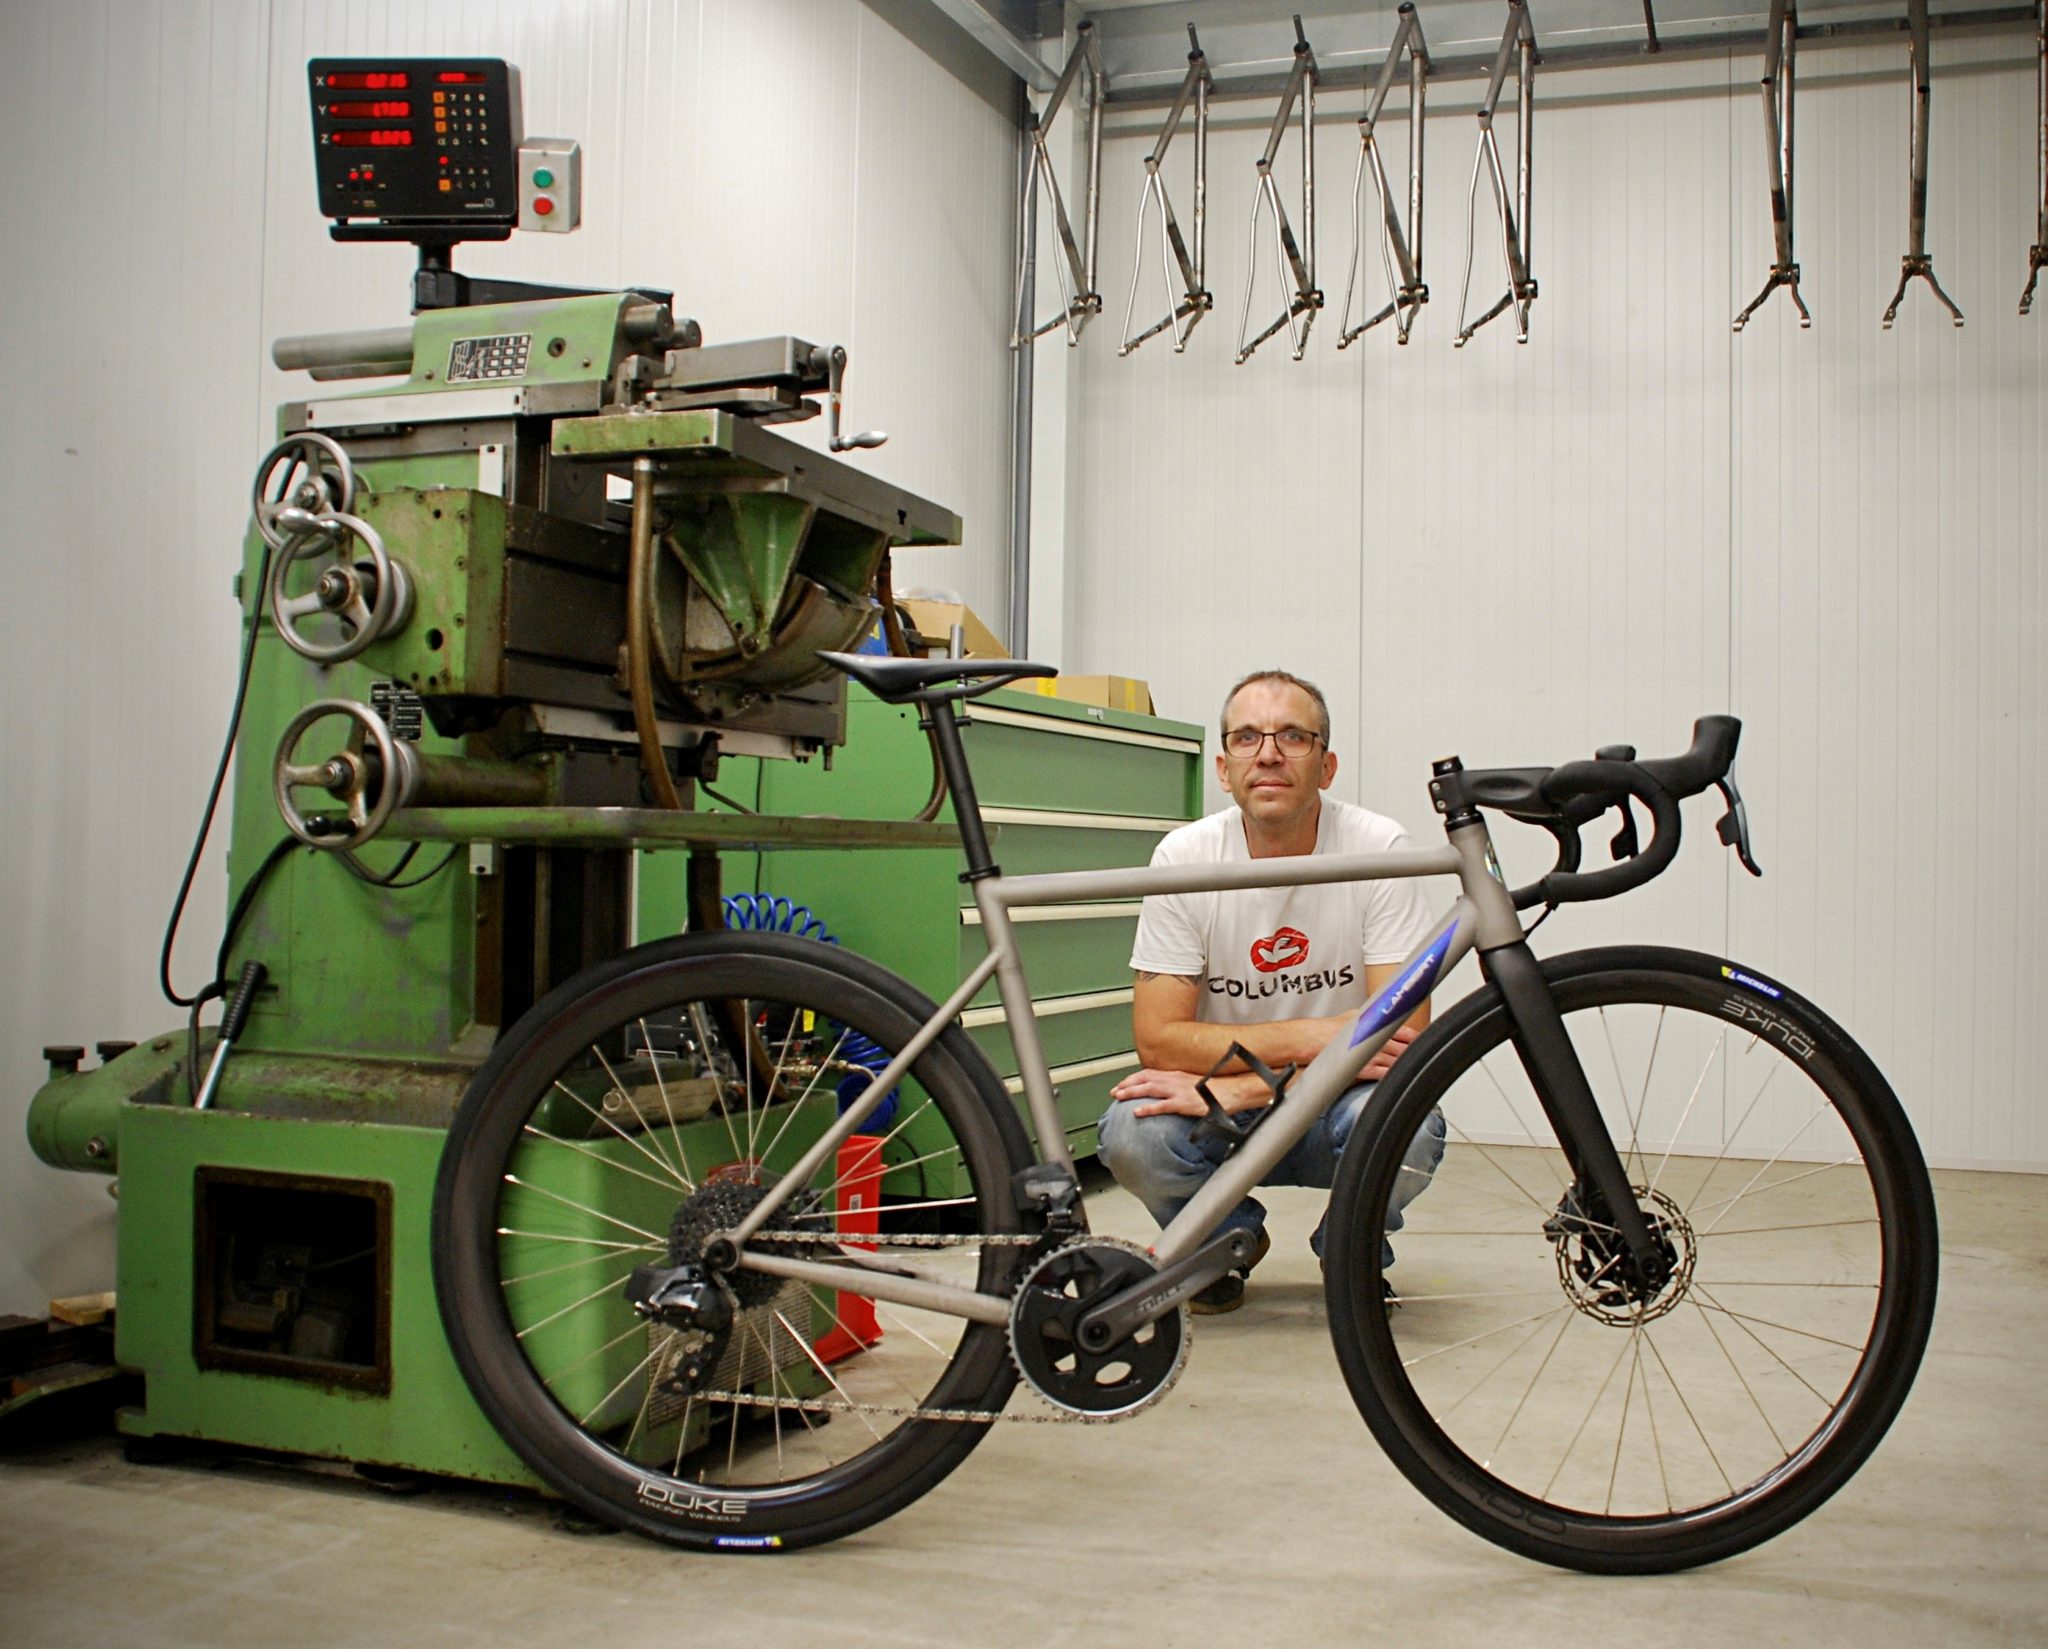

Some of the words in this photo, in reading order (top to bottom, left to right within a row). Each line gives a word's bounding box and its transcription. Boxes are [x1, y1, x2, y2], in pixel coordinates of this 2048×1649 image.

[316, 76, 325, 86] X
[318, 105, 327, 115] Y
[320, 133, 329, 144] Z
[1381, 953, 1436, 1015] LAMBERT
[1737, 973, 1781, 997] MICHELIN
